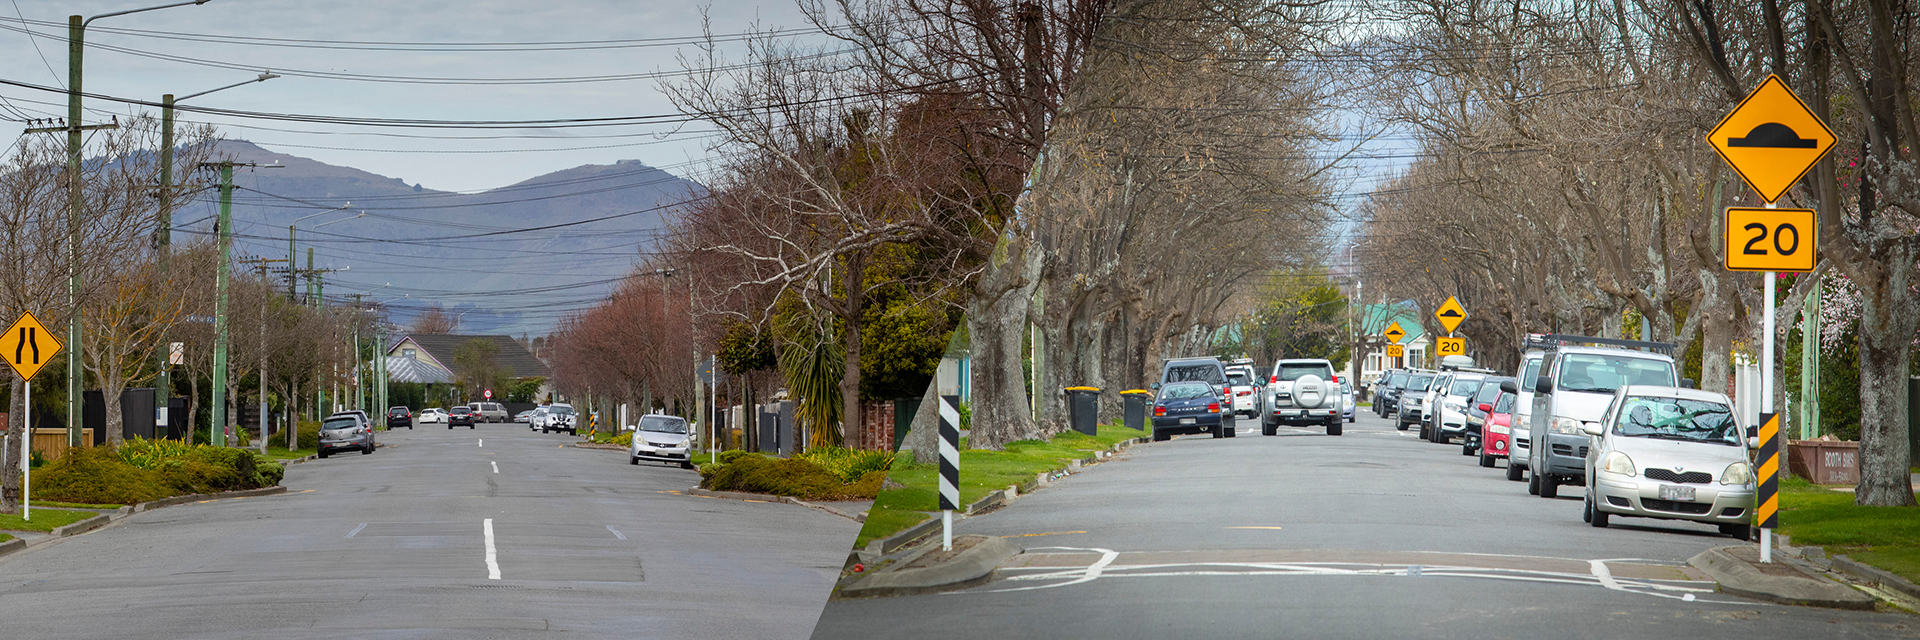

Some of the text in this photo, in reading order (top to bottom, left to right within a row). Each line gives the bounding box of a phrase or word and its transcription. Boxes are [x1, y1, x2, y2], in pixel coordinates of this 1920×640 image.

[1743, 222, 1799, 256] 20
[1389, 347, 1400, 355] 20
[1441, 341, 1460, 353] 20
[1825, 451, 1842, 468] BOOTH
